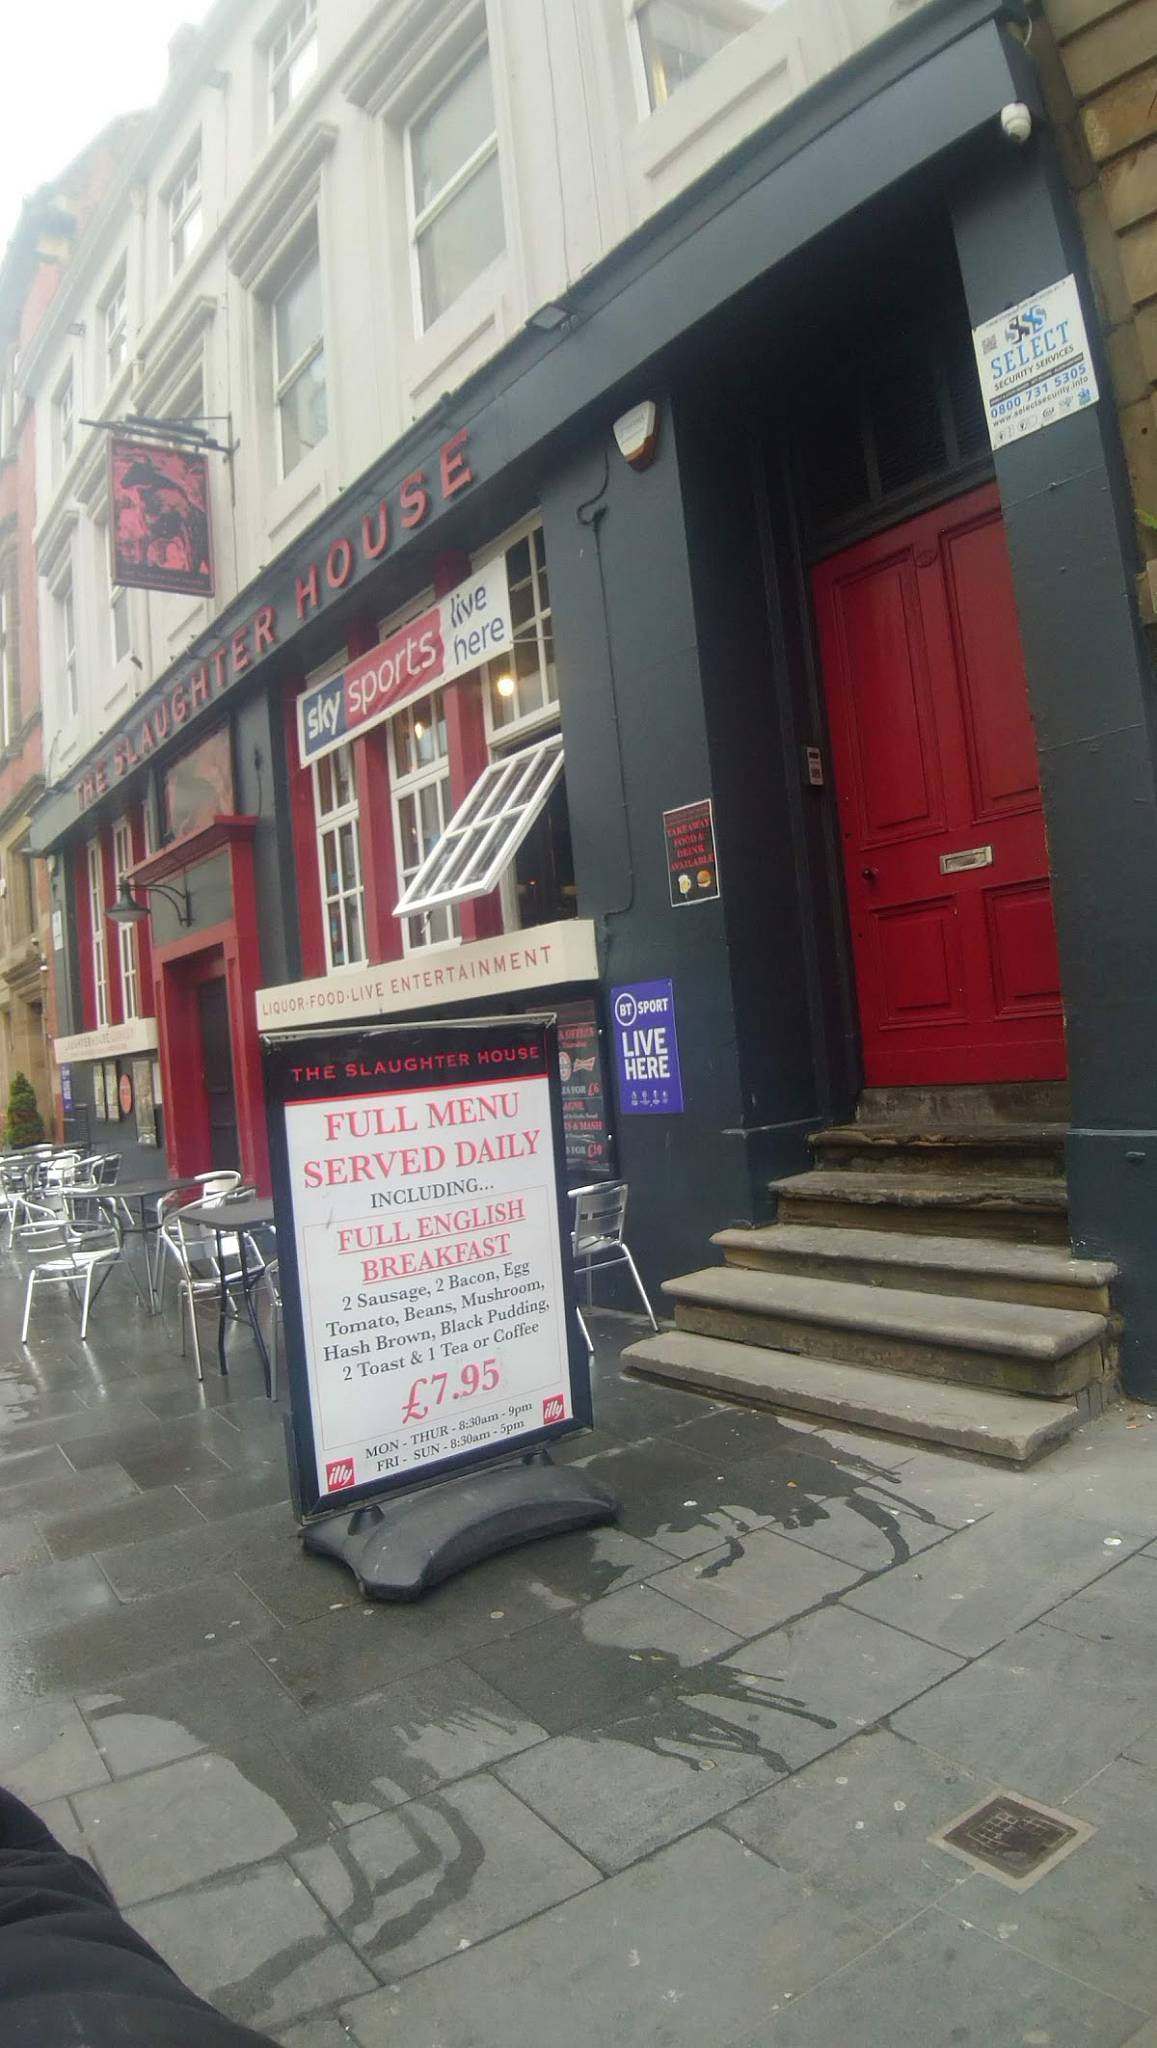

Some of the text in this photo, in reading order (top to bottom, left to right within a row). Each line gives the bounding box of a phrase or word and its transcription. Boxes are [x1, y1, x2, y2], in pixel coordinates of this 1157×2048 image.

[991, 321, 1068, 380] SELECT
[994, 365, 1034, 391] SECURITY
[1036, 344, 1074, 369] SERVICES
[991, 396, 1021, 418] 0800
[1026, 383, 1048, 402] 731
[1054, 363, 1087, 387] 5305
[75, 429, 474, 809] THE SLAUGHTER HOUSE
[450, 585, 487, 628] live
[454, 616, 505, 665] here
[307, 631, 436, 739] sky sports
[391, 945, 552, 994] ENTERTAINMENT
[619, 998, 669, 1017] BT SPORT
[291, 1046, 539, 1082] THE SLAUGHTER HOUSE
[622, 1027, 668, 1057] LIVE
[624, 1055, 670, 1080] HERE
[324, 1092, 519, 1142] FULL MENU
[303, 1129, 541, 1189] SERVED DAILY
[337, 1198, 525, 1252] FULL ENGLISH
[360, 1233, 511, 1283] BREAKFAST
[326, 1279, 545, 1338] Tomato, Beans, Mushroom,
[342, 1260, 530, 1311] 2 Sausage, 2 Bacon, Egg
[323, 1298, 550, 1362] Hash Brown, Black Pudding,
[342, 1321, 539, 1381] 2 Toast & 1 Tea or Coffee
[402, 1358, 500, 1424] £7.95
[544, 1400, 565, 1420] illy
[365, 1440, 399, 1459] MON
[410, 1425, 449, 1446] THUR
[458, 1412, 499, 1432] 8:30am
[508, 1401, 533, 1417] 9pm
[377, 1456, 399, 1473] FRI
[413, 1444, 440, 1461] SUN
[450, 1429, 491, 1449] 8:30am
[500, 1419, 525, 1436] 5pm
[328, 1465, 353, 1488] illy
